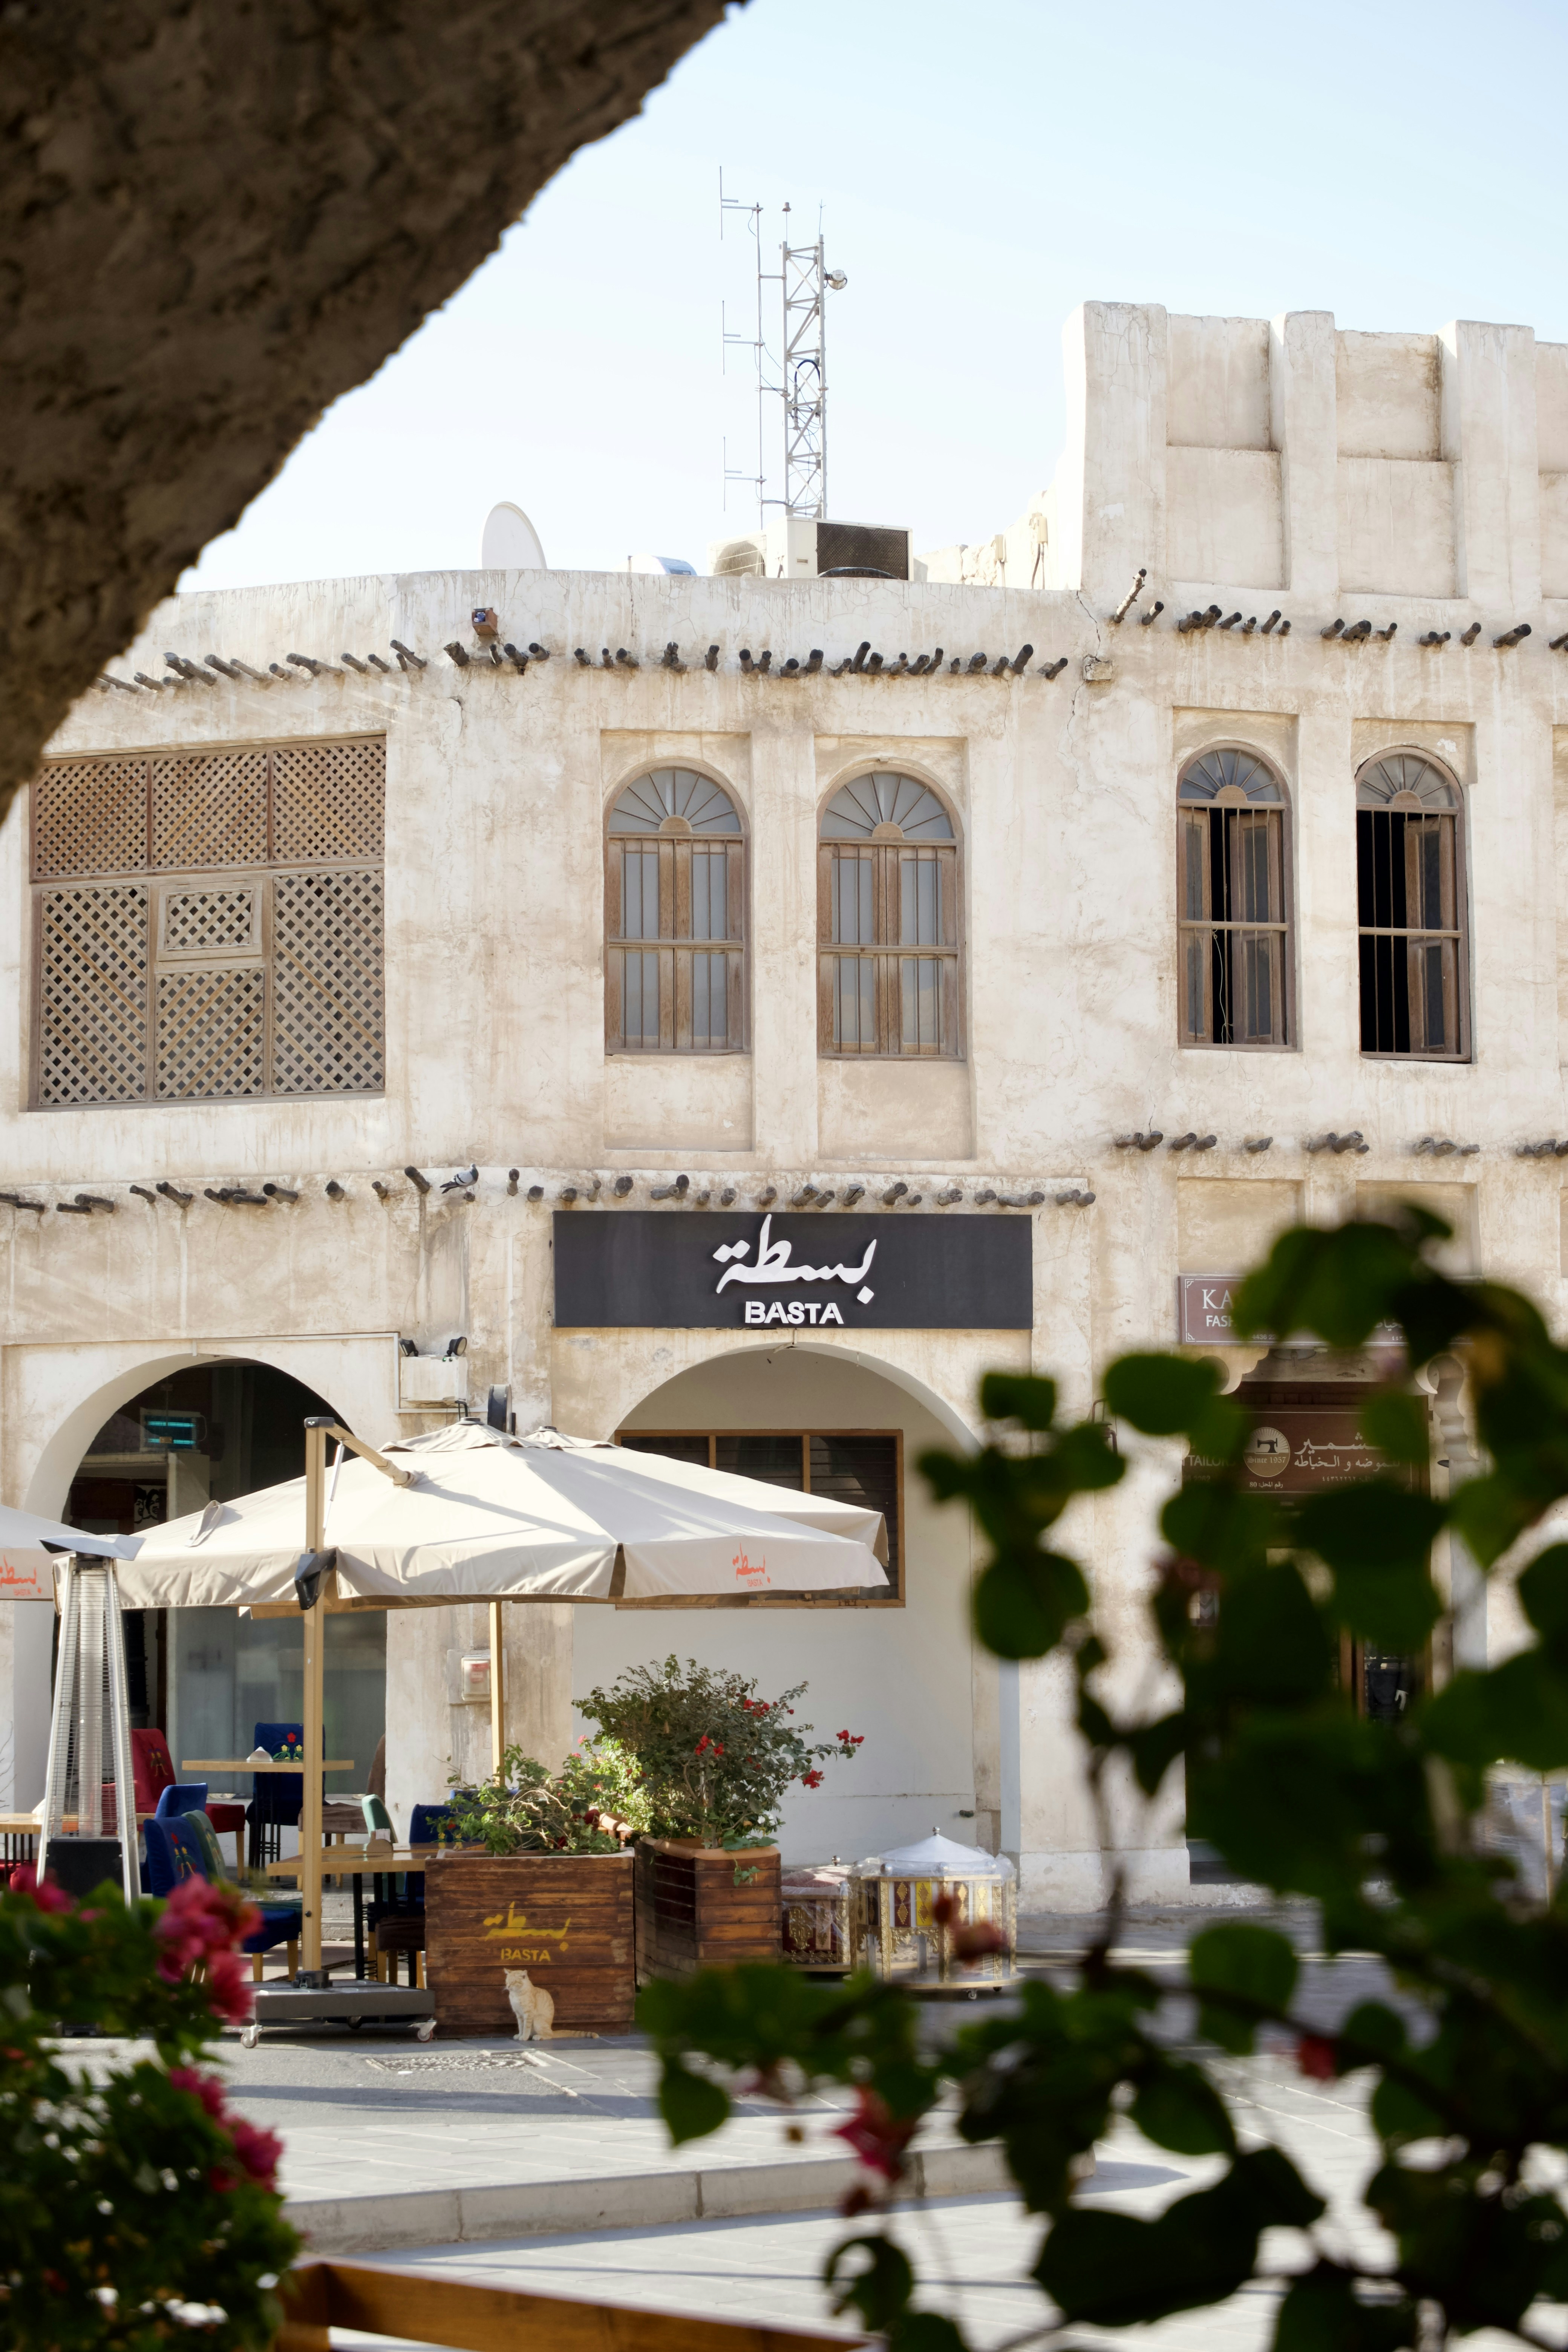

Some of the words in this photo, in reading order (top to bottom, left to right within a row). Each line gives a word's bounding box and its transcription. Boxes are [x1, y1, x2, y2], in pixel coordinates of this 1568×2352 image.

[712, 1213, 877, 1304] بسطة
[744, 1301, 844, 1325] BASTA
[732, 1542, 771, 1584] بسطة
[747, 1579, 763, 1587] BASTA
[482, 1901, 572, 1952] بسطة
[501, 1948, 551, 1961] BASTA
